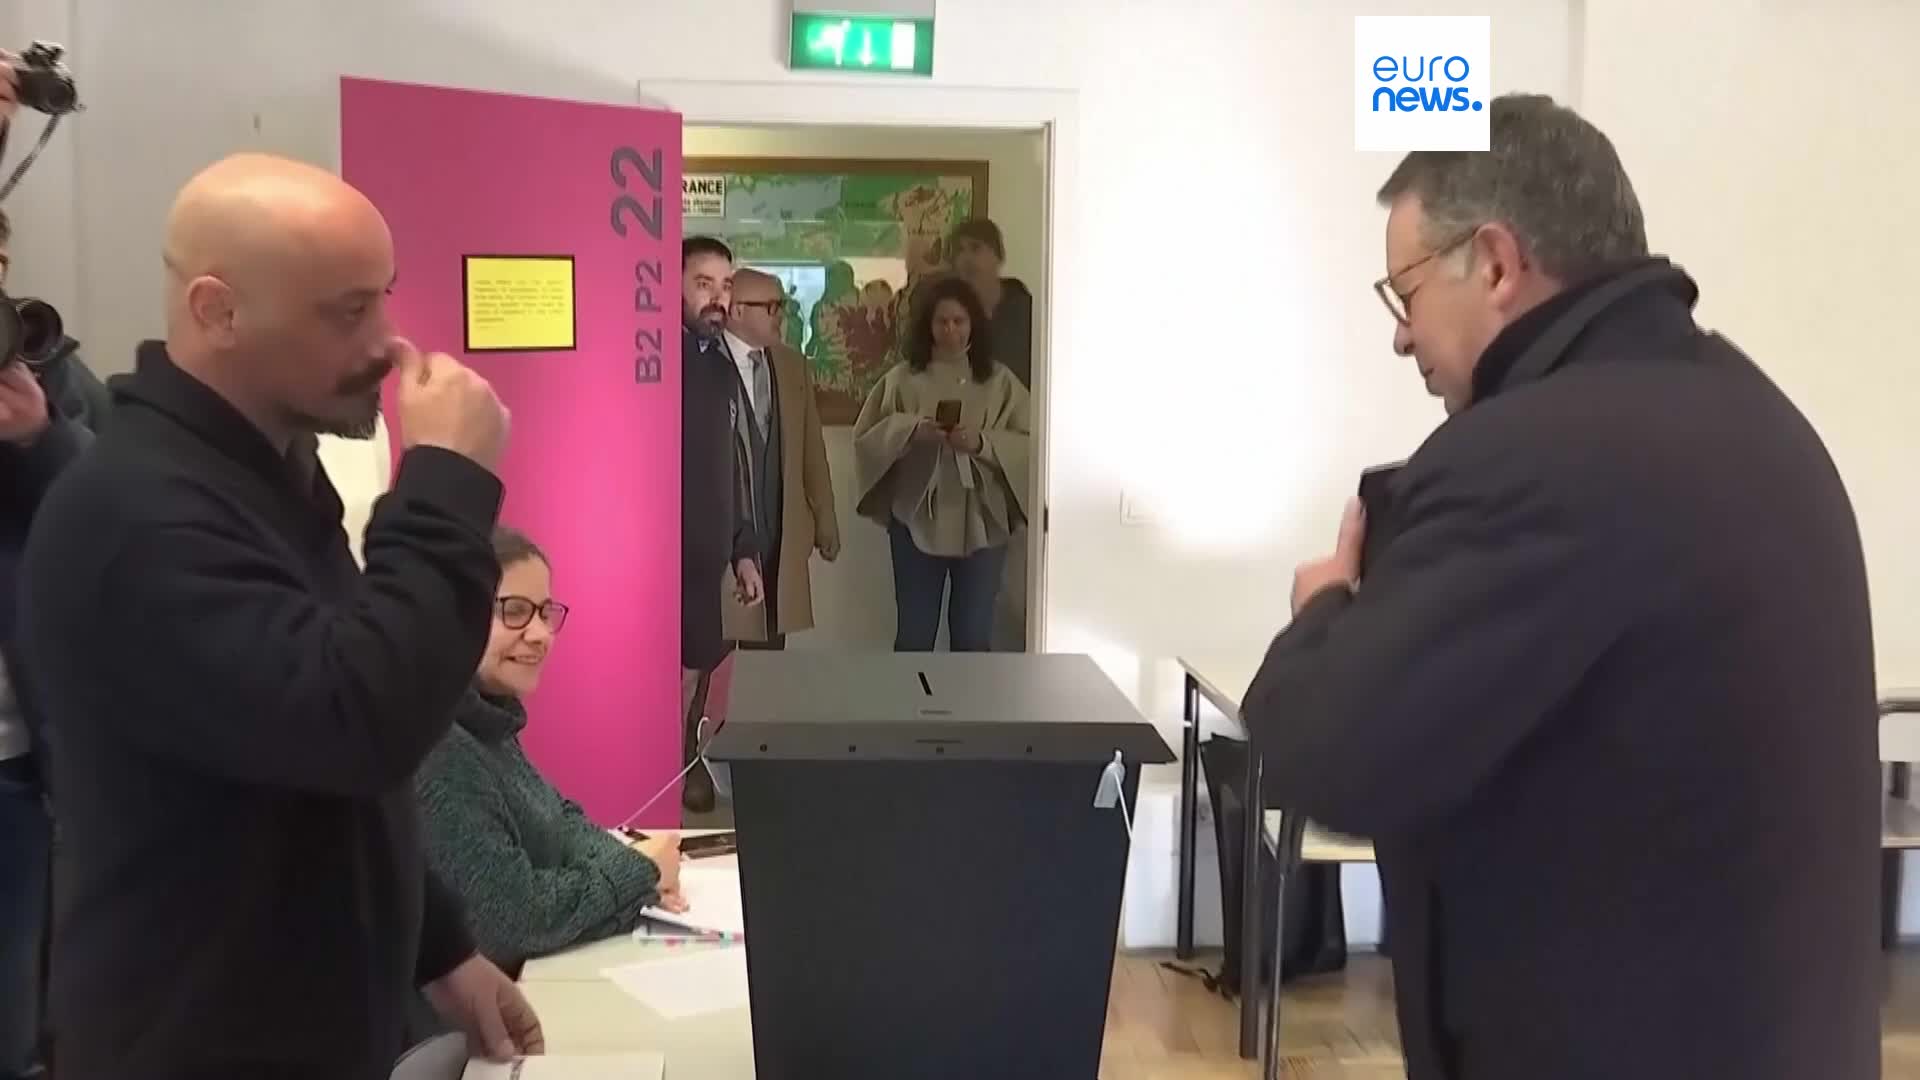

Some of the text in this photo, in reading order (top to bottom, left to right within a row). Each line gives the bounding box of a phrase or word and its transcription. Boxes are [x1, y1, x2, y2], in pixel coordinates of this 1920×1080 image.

[610, 146, 663, 383] B2 P2 22
